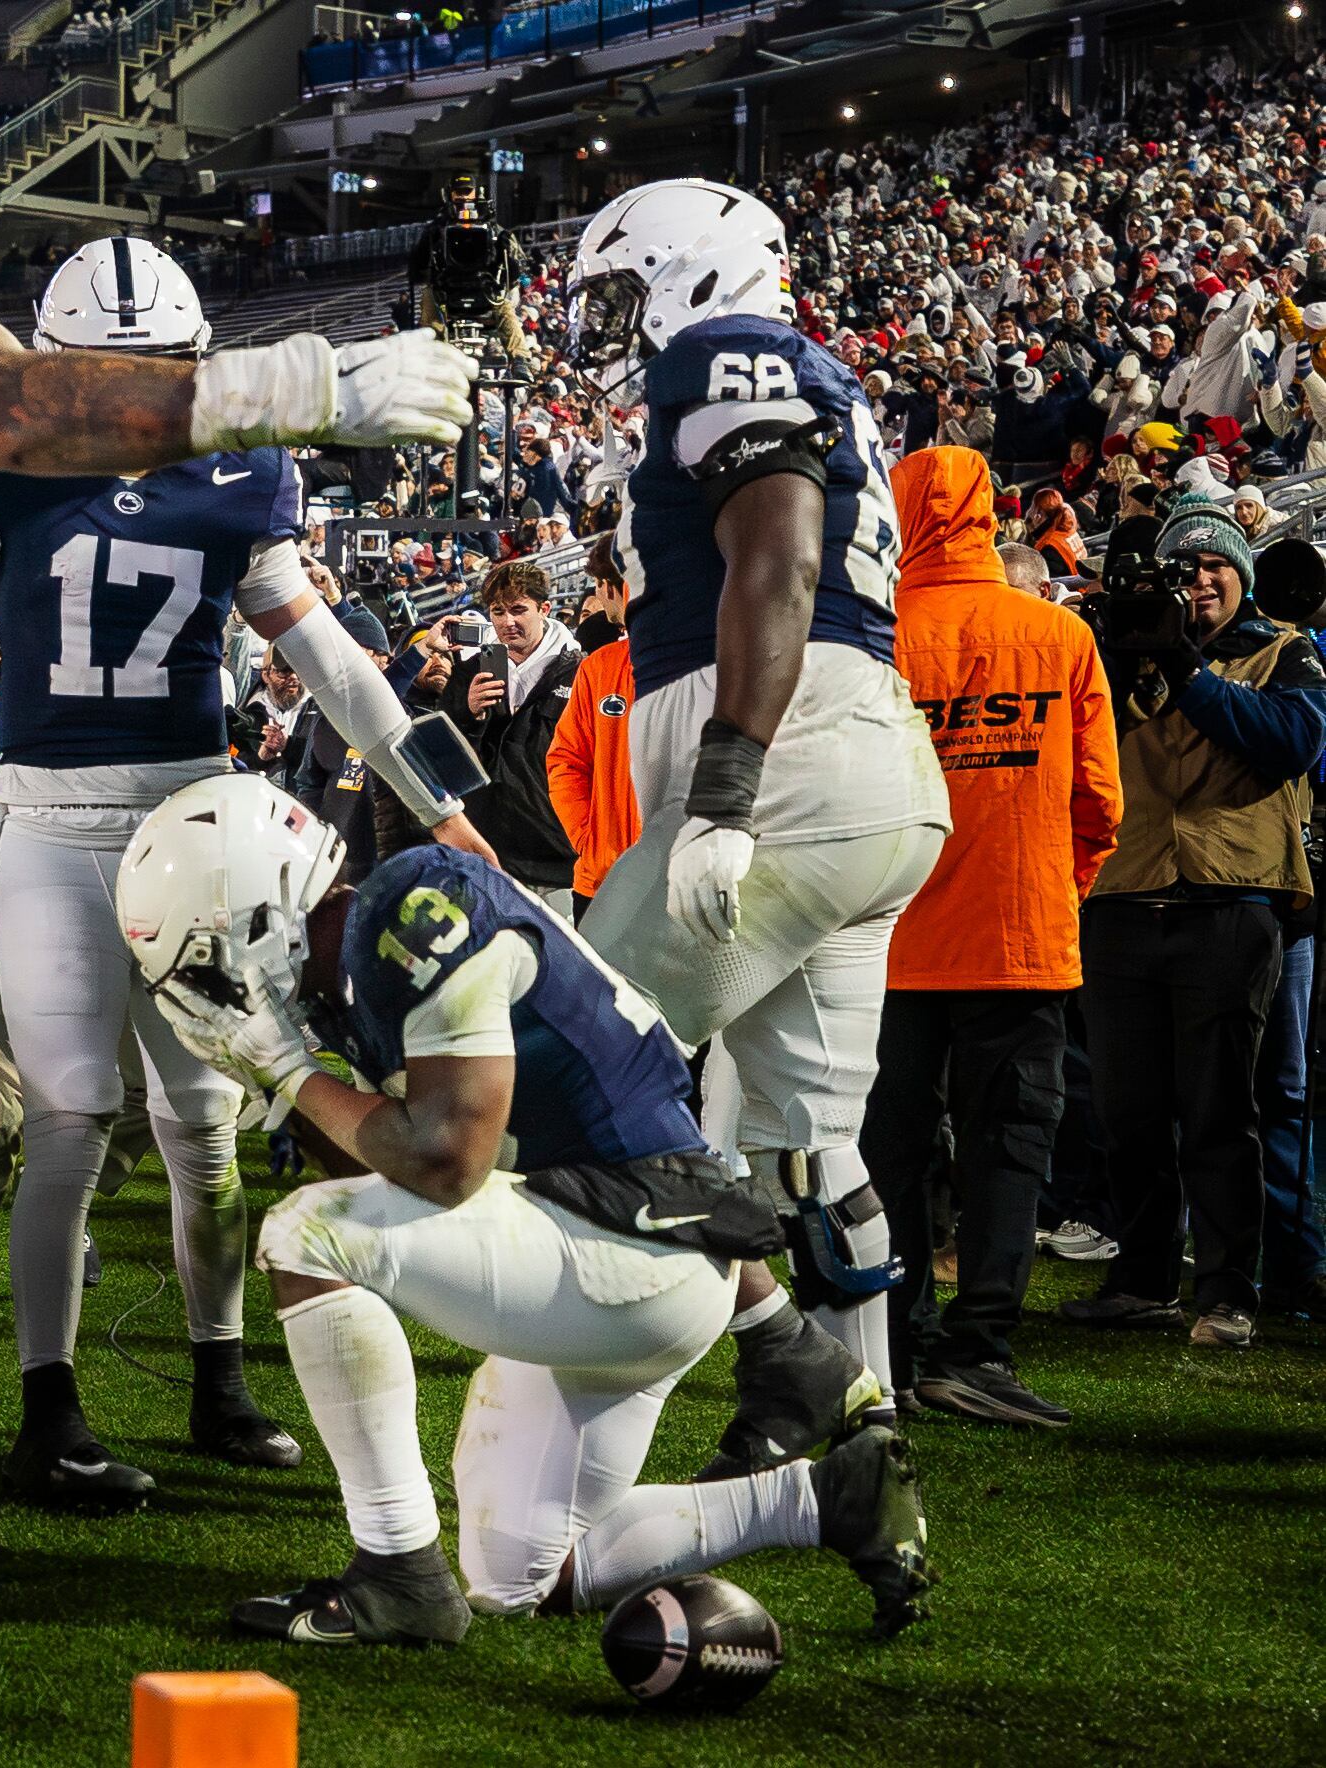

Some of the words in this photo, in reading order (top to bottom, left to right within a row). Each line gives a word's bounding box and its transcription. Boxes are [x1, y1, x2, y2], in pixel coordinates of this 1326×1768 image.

[707, 352, 798, 402] 68
[50, 533, 205, 698] 17
[914, 691, 1063, 731] BEST
[377, 886, 471, 991] 13
